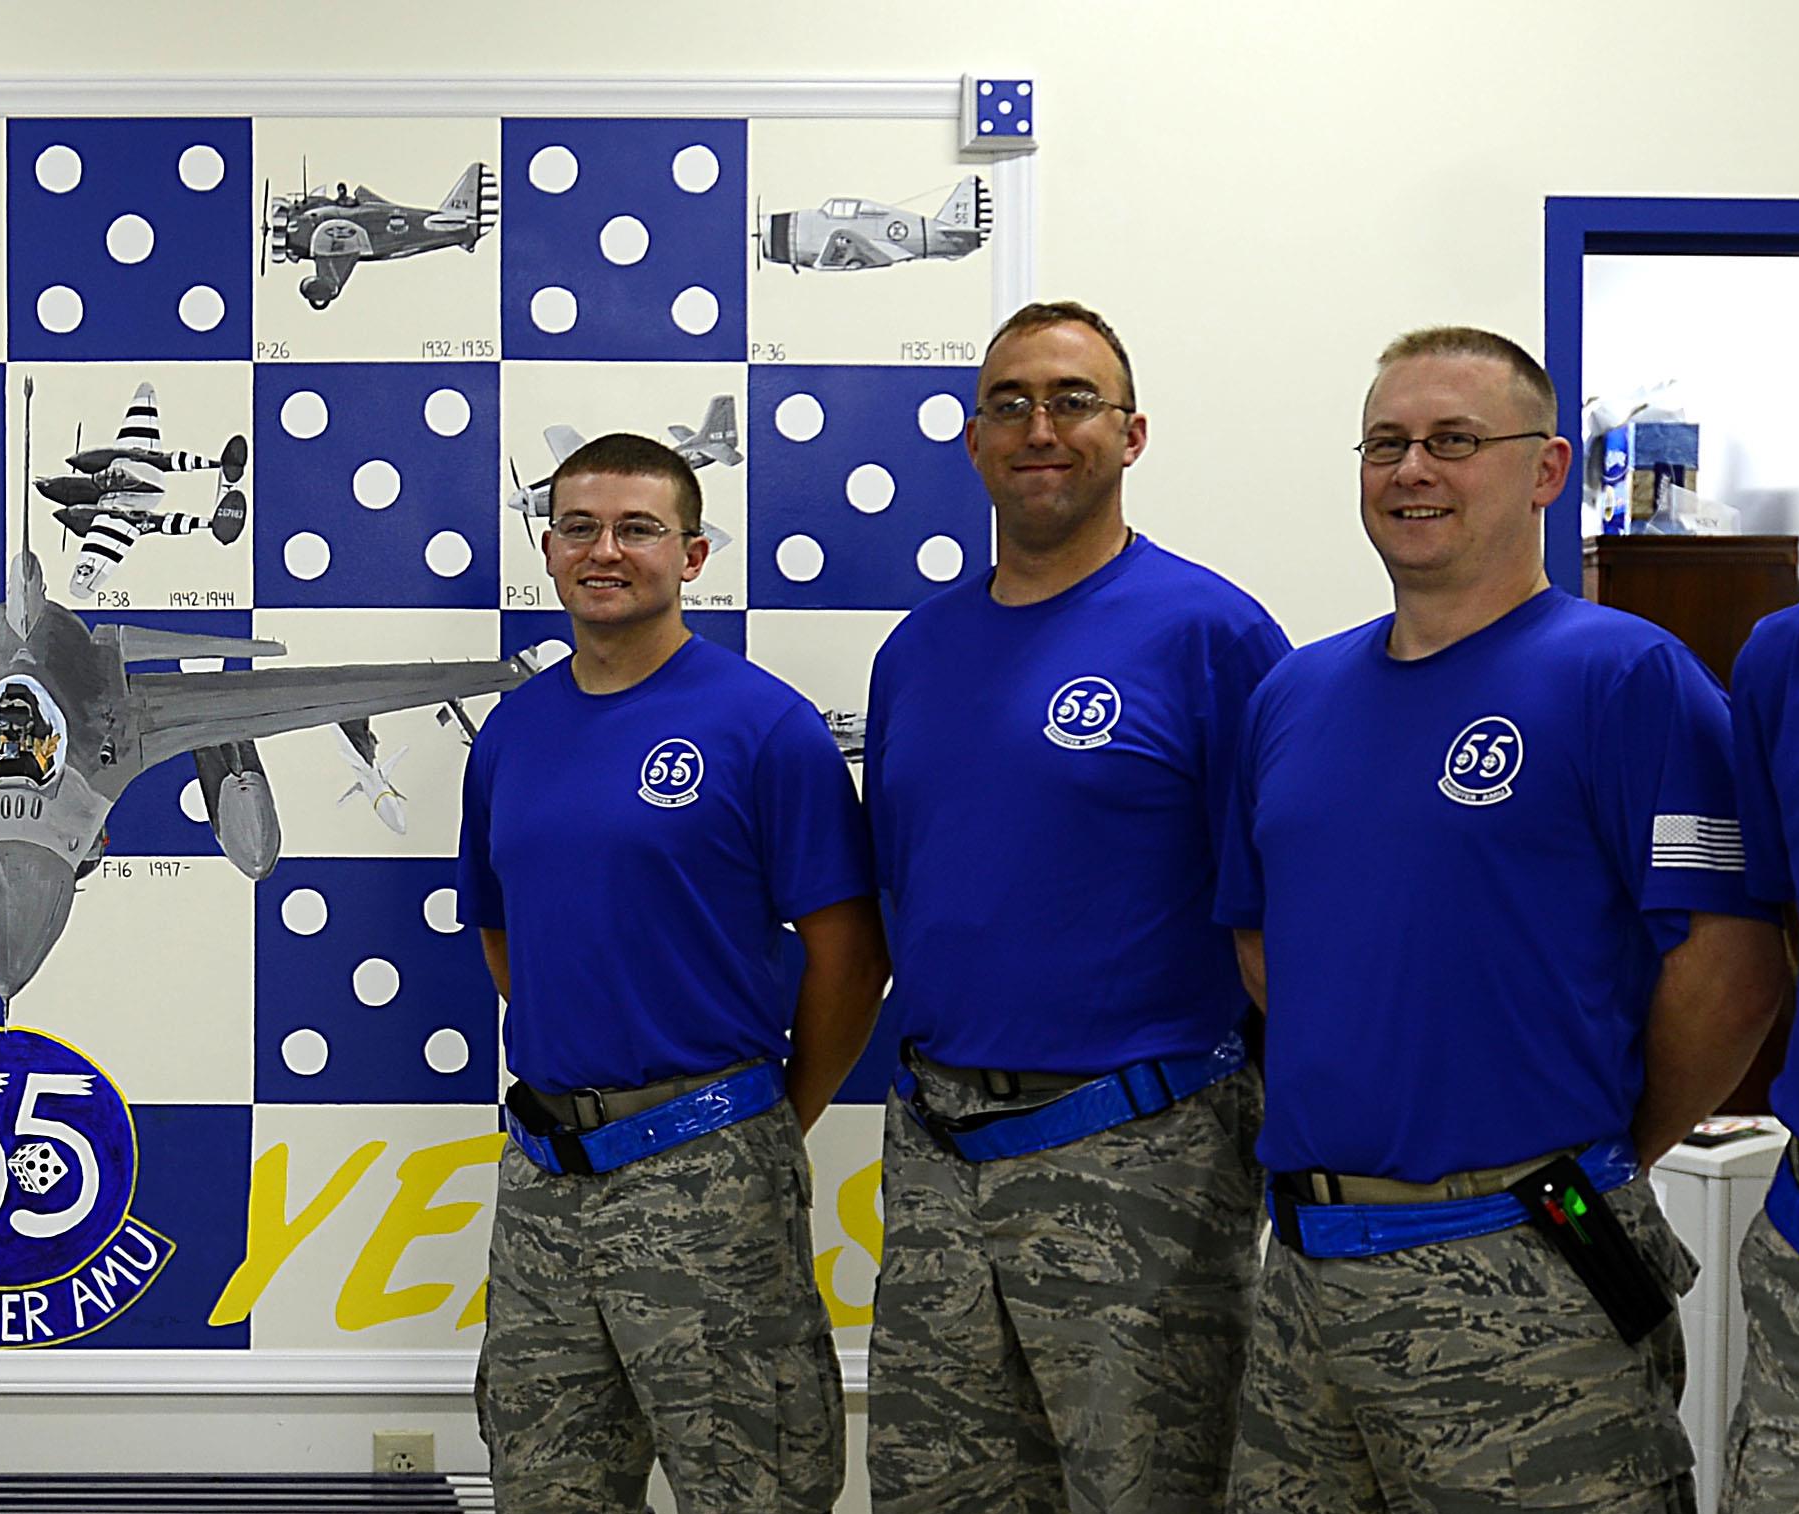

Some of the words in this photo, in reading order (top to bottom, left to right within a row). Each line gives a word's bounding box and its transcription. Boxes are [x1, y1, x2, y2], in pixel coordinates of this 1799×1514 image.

[257, 341, 290, 360] P-26
[751, 343, 786, 362] P-36
[97, 591, 131, 608] P-38
[506, 586, 541, 606] P-51
[1056, 690, 1113, 727] 55
[1452, 733, 1515, 778] 55
[648, 751, 696, 786] 55
[103, 861, 132, 878] F-16
[72, 1226, 159, 1328] AMU
